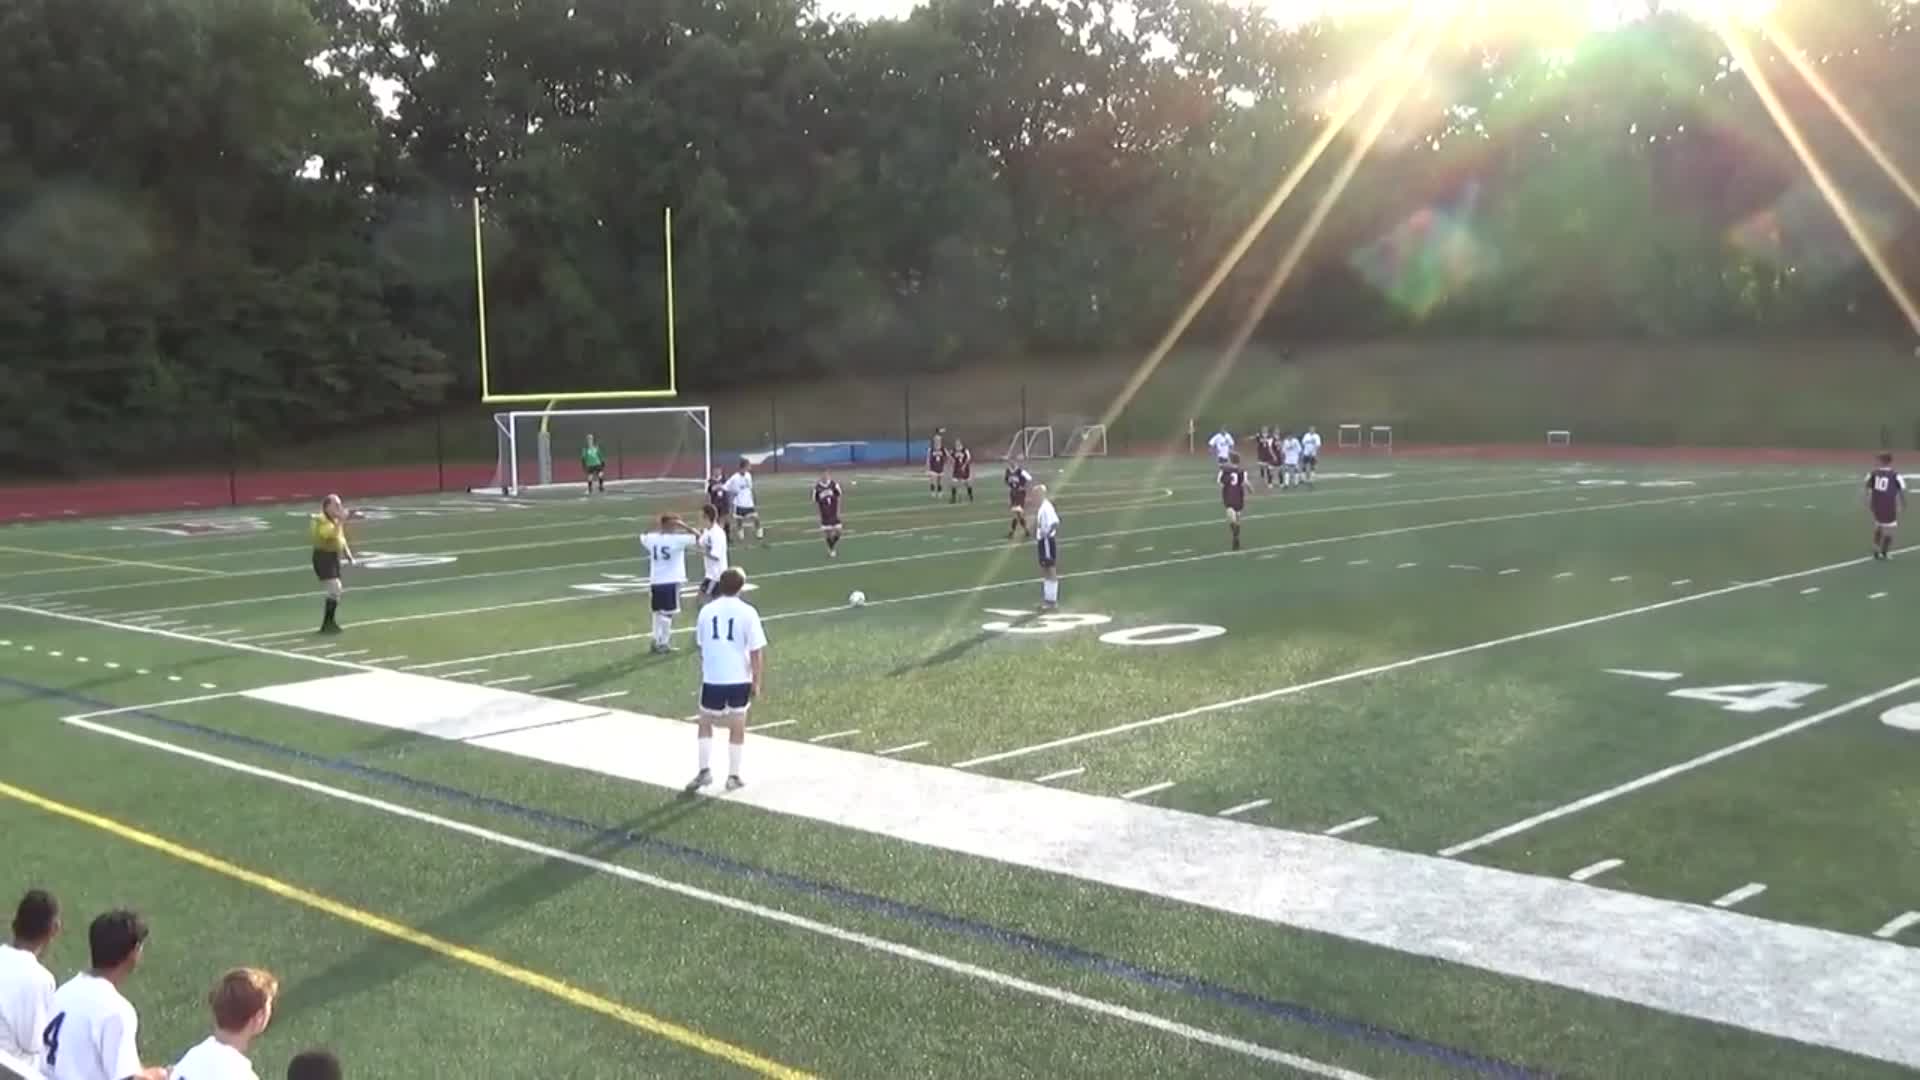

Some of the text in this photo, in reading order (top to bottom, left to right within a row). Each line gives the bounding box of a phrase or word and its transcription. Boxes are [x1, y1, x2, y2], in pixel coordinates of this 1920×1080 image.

[1230, 472, 1239, 486] 3
[1874, 475, 1890, 492] 10
[652, 545, 672, 561] 15
[711, 615, 735, 642] 11
[43, 1011, 66, 1067] 4
